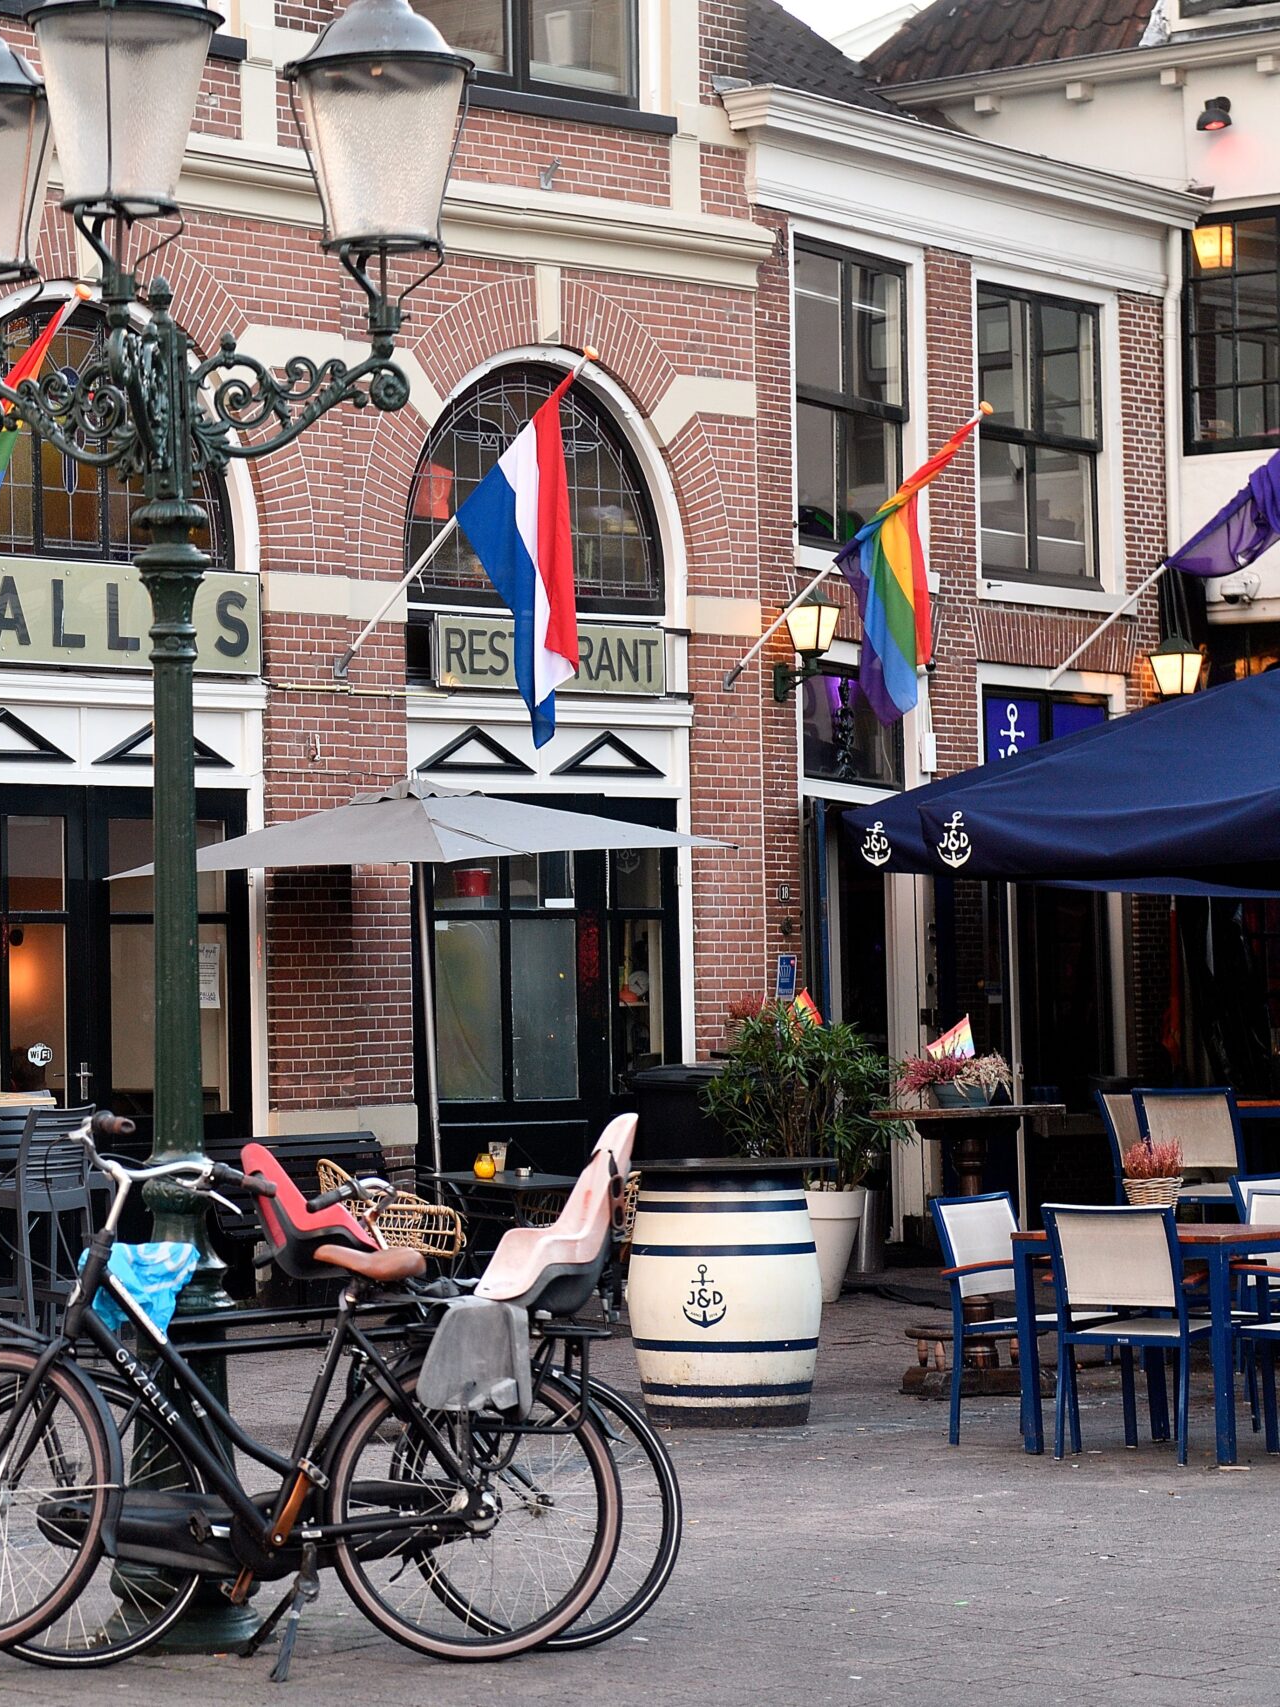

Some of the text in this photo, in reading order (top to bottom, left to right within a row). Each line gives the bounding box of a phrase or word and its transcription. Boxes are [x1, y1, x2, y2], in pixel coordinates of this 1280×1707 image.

[444, 627, 659, 684] RESRANT
[863, 834, 888, 851] J&D
[938, 829, 968, 850] J&D
[781, 886, 789, 897] 18
[686, 1288, 723, 1308] J&D
[115, 1348, 181, 1426] GAZELLE
